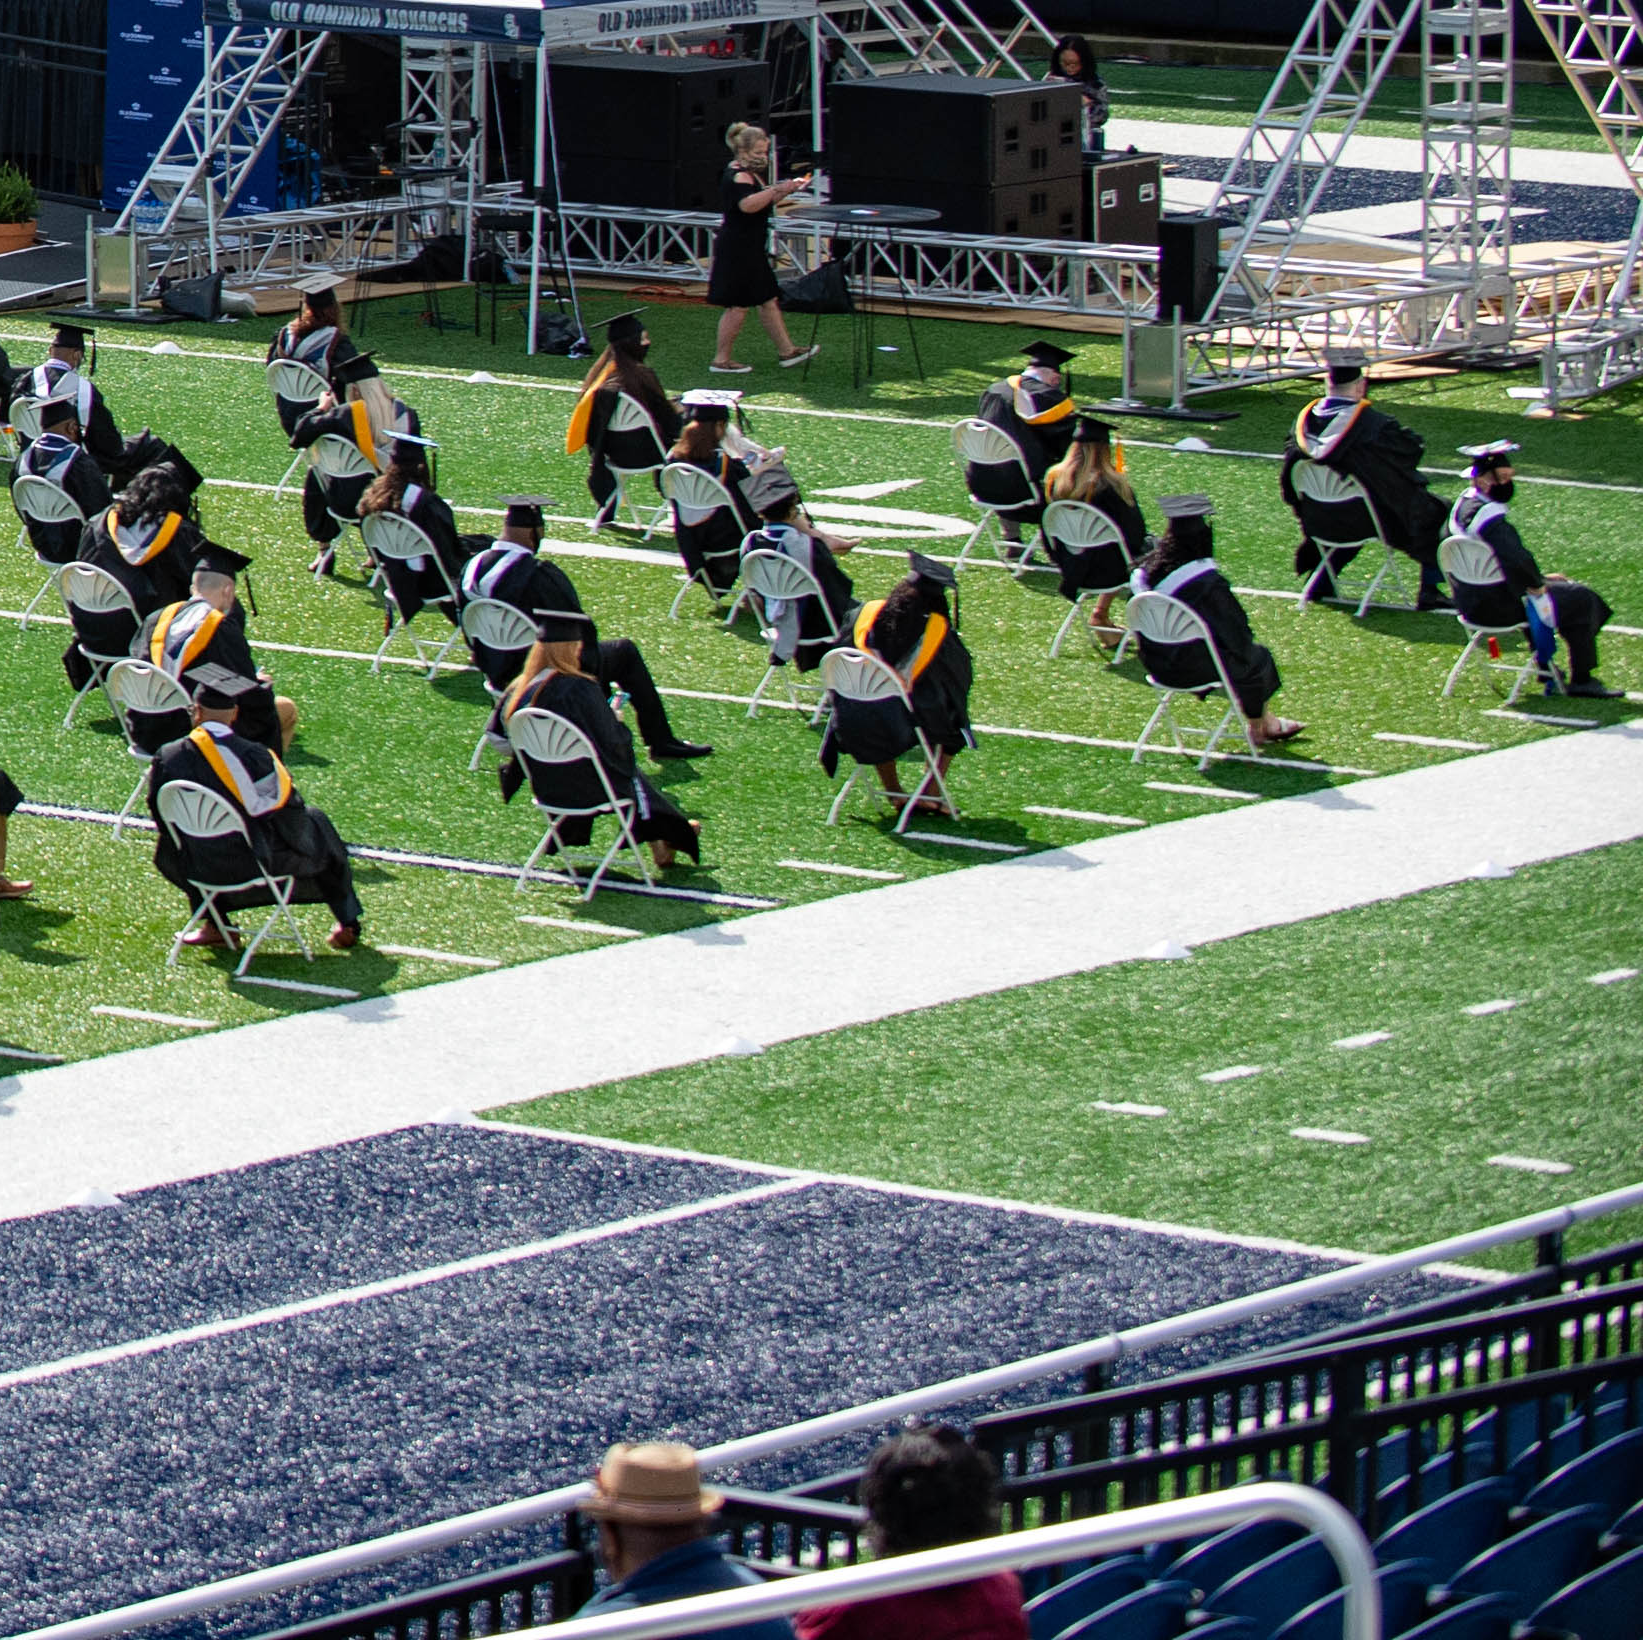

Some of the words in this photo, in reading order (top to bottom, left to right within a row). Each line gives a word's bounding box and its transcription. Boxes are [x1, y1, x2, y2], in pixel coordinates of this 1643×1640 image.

[270, 0, 300, 22] OLD
[303, 3, 381, 28] DOMINION
[383, 8, 469, 33] MONARCHS
[598, 11, 622, 33] OLD
[625, 3, 688, 29] DOMINION
